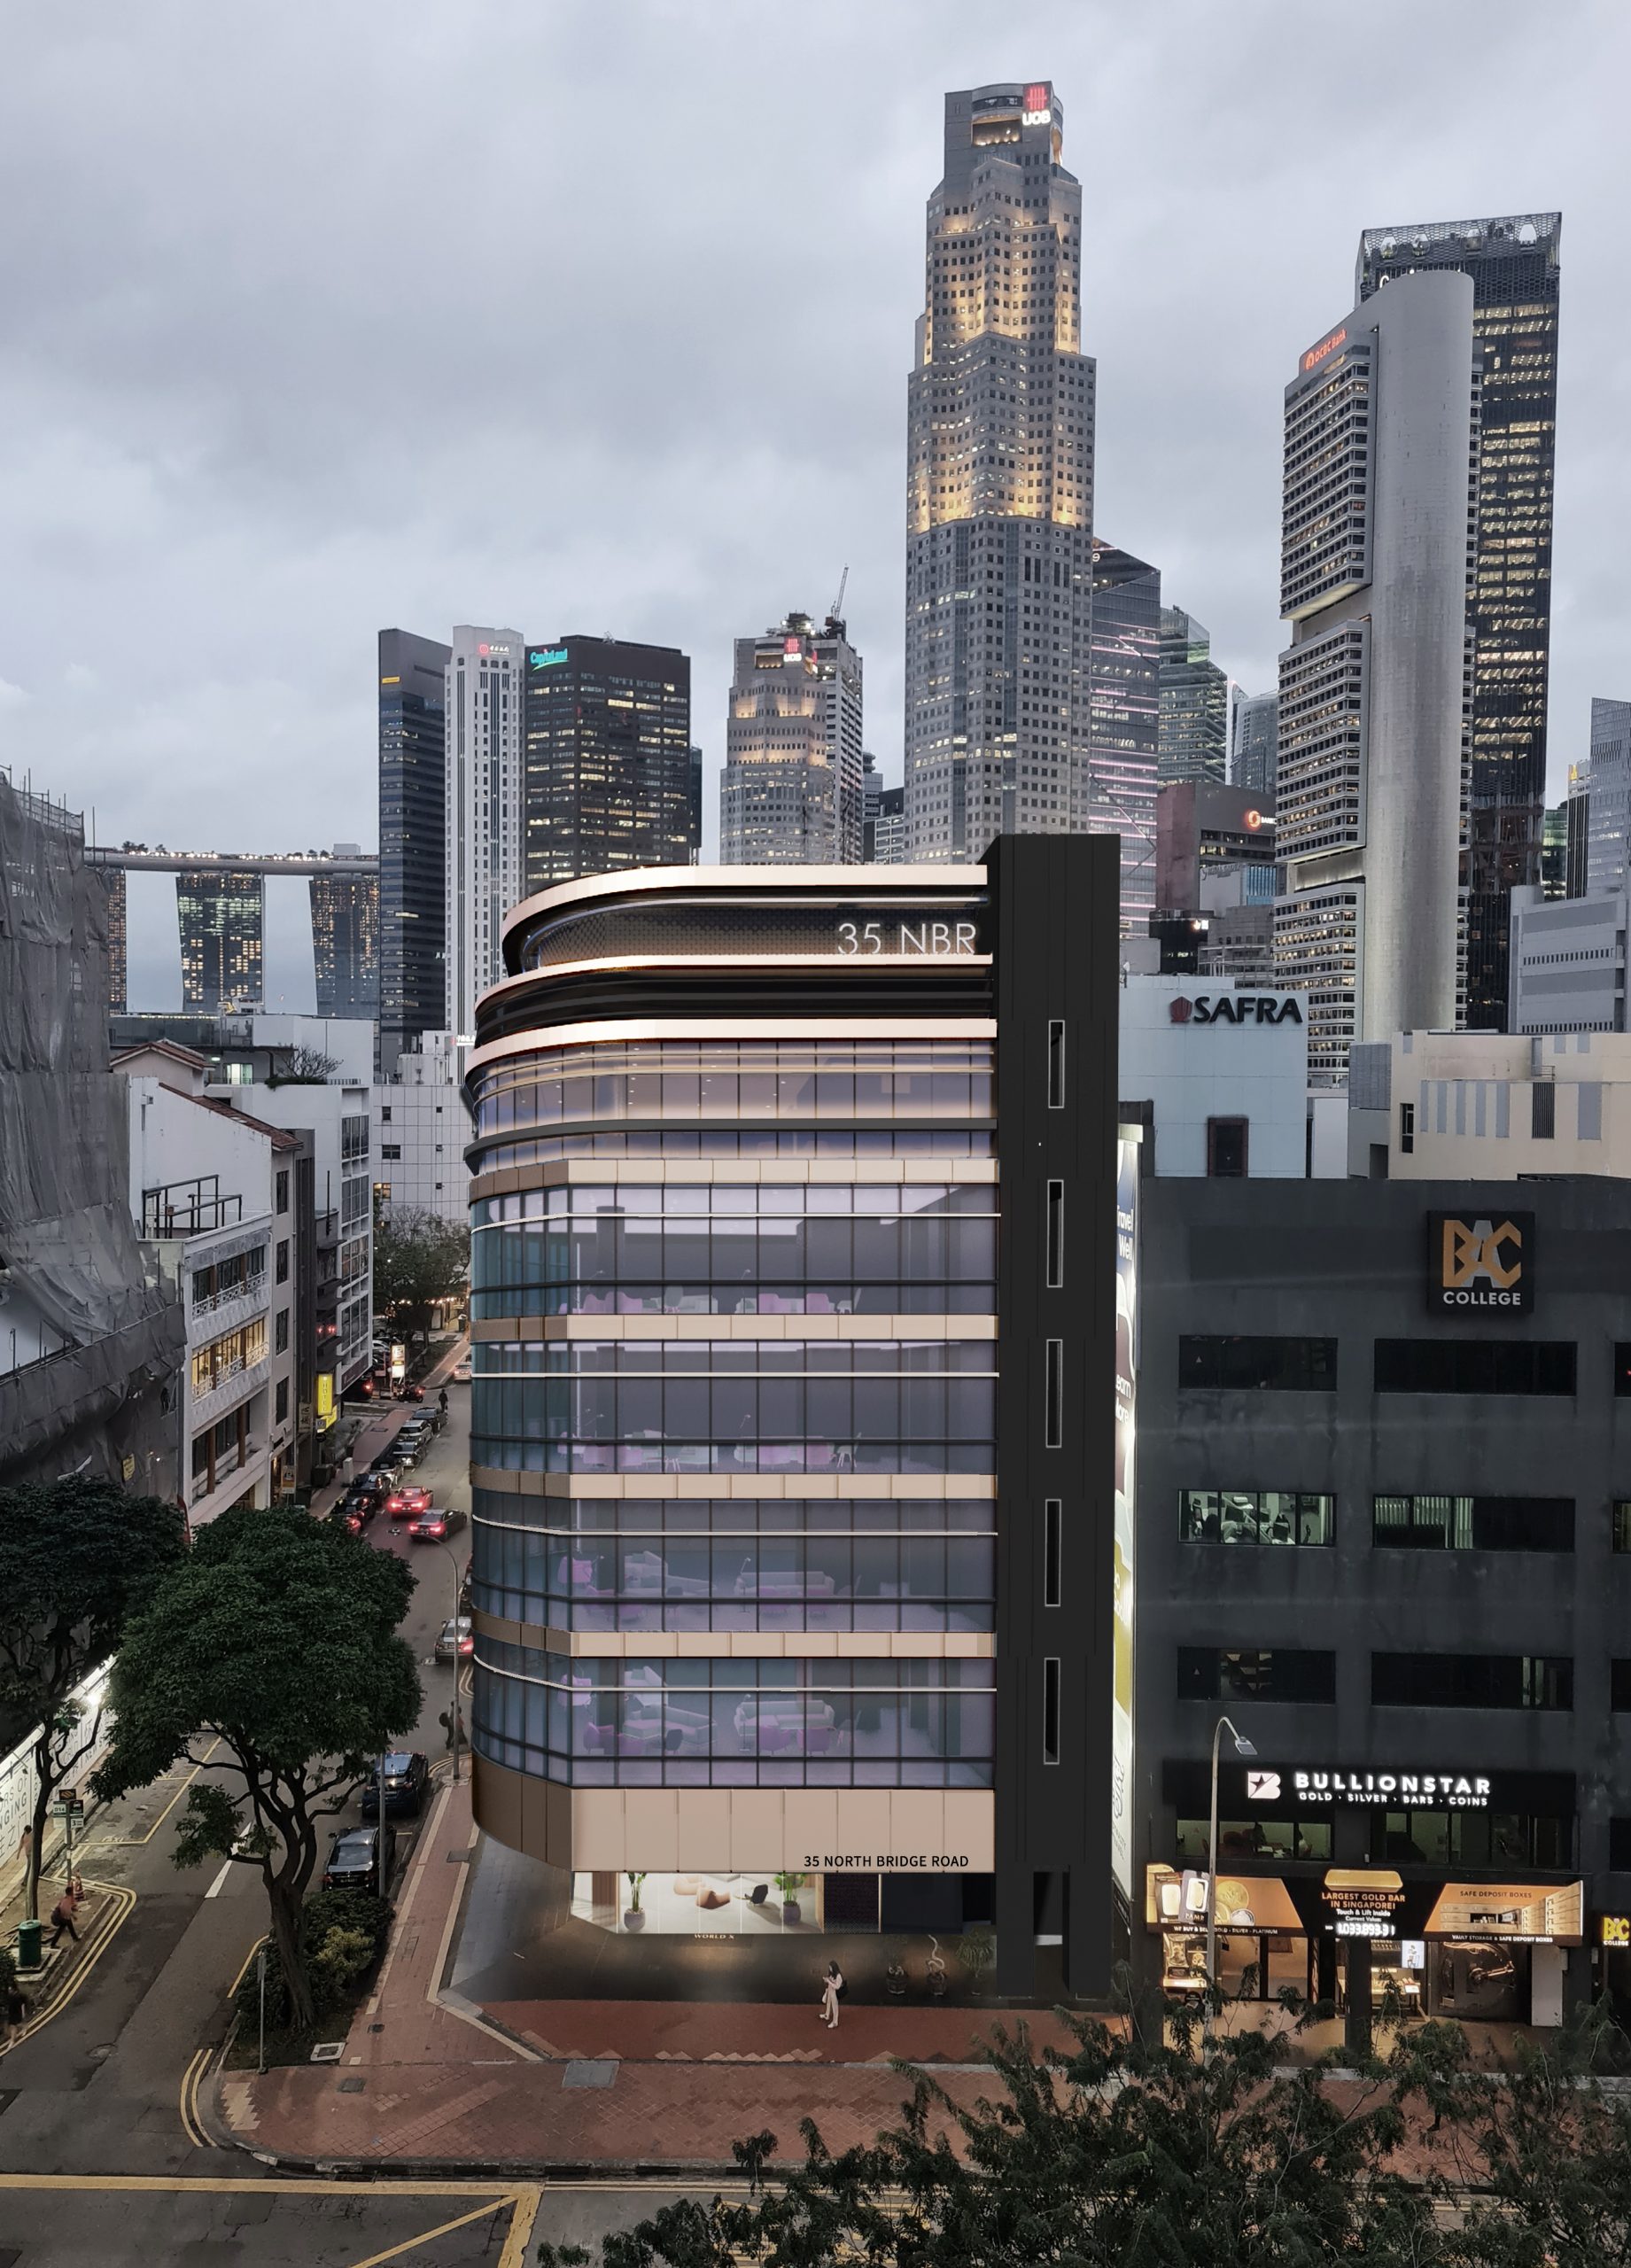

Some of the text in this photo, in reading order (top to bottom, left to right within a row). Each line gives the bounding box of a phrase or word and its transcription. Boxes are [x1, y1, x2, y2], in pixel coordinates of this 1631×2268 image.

[1022, 110, 1052, 126] UOB
[1315, 328, 1346, 362] OCBC Bank
[530, 648, 568, 666] CapitaLand
[837, 922, 976, 954] 35 NBR
[1194, 996, 1303, 1023] SAFRA
[1117, 1204, 1133, 1232] ravel
[1442, 1292, 1522, 1306] COLLEGE
[1116, 1373, 1131, 1400] earn
[1294, 1771, 1491, 1795] BULLIONSTAR
[1299, 1792, 1488, 1806] GOLD SILVER BARS COINS
[804, 1855, 969, 1868] 35 NORTH BRIDGE ROAD
